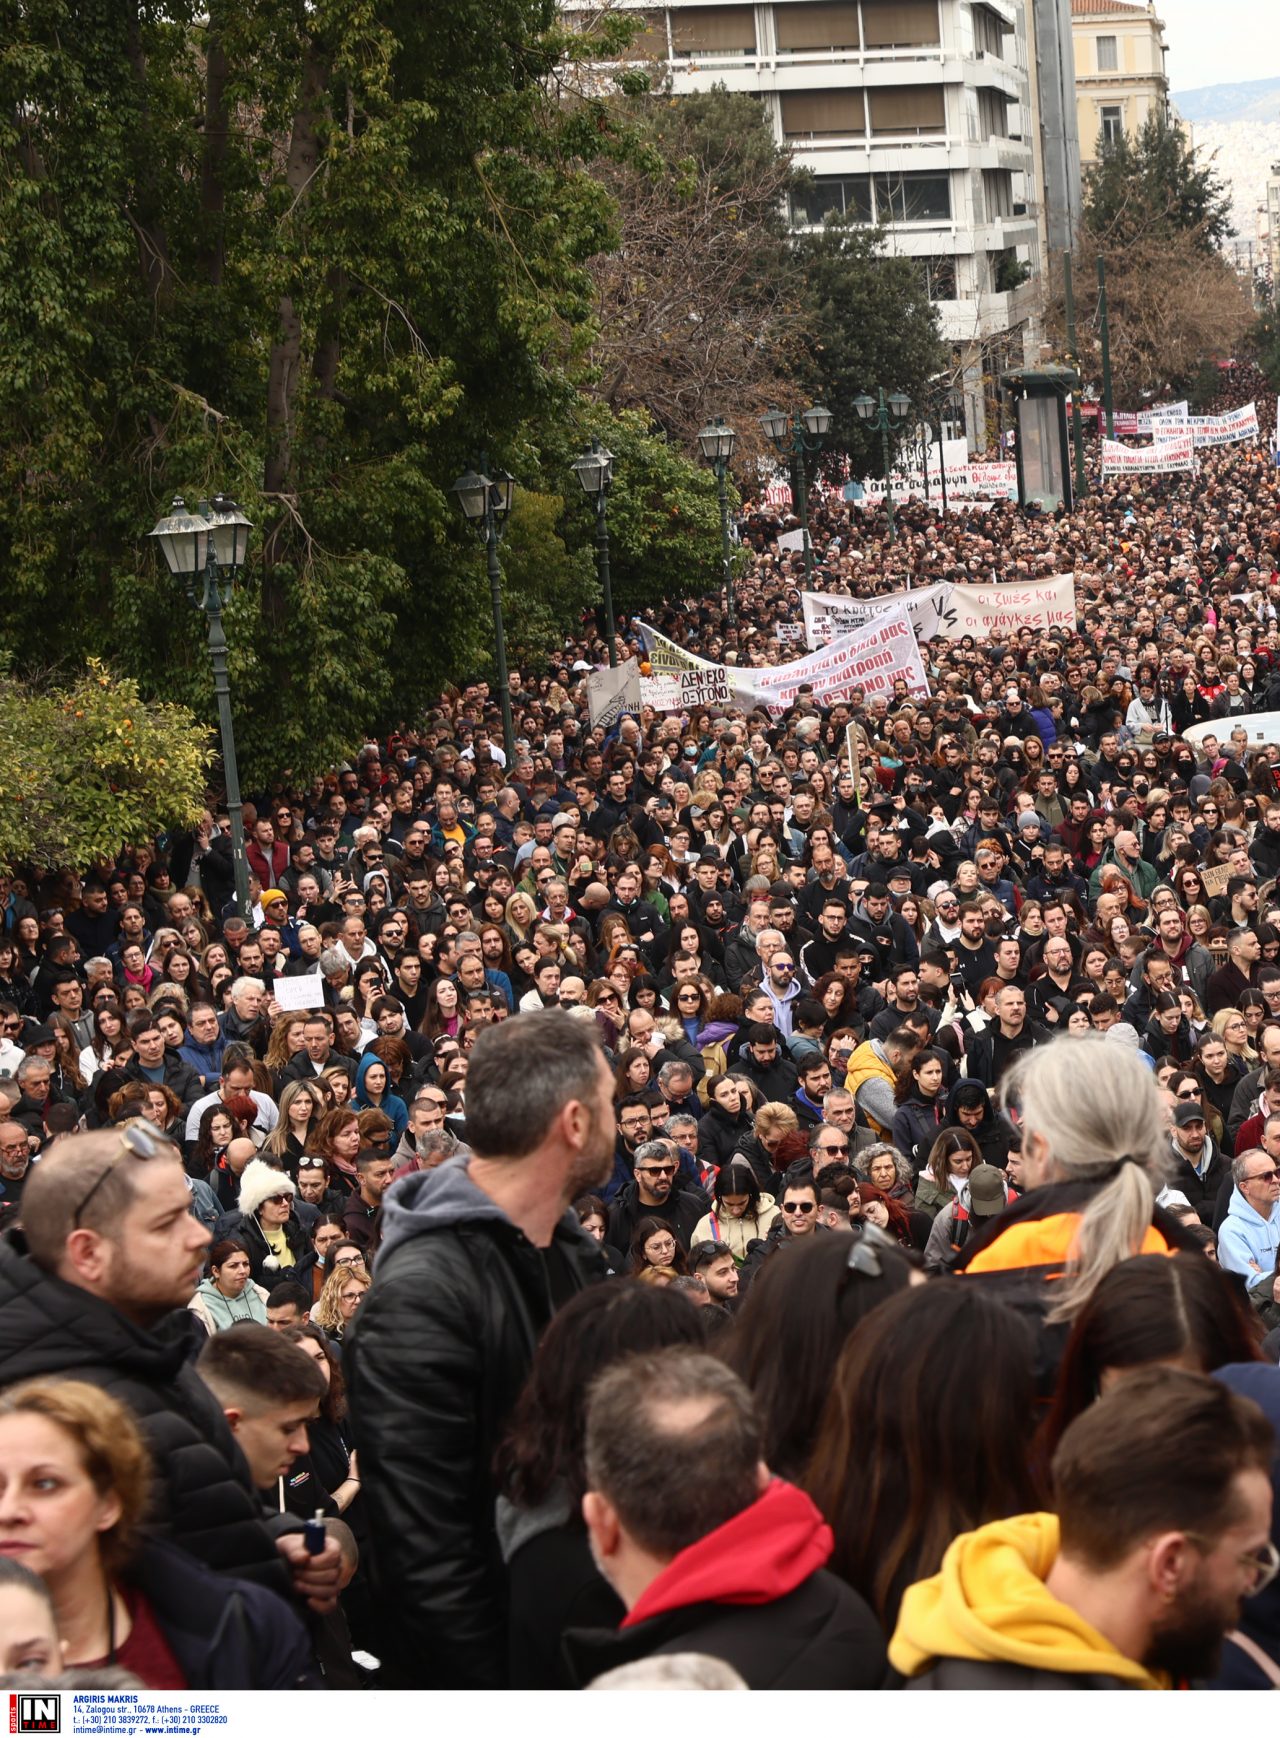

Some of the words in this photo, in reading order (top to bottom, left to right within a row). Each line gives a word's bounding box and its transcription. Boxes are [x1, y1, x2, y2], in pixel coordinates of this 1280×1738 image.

[1036, 589, 1057, 601] και
[1046, 610, 1074, 625] μας
[681, 671, 704, 689] ΔΕΝ
[707, 668, 726, 685] ΕΧΩ
[682, 685, 728, 705] ΟΞΥΓΟΝΟ
